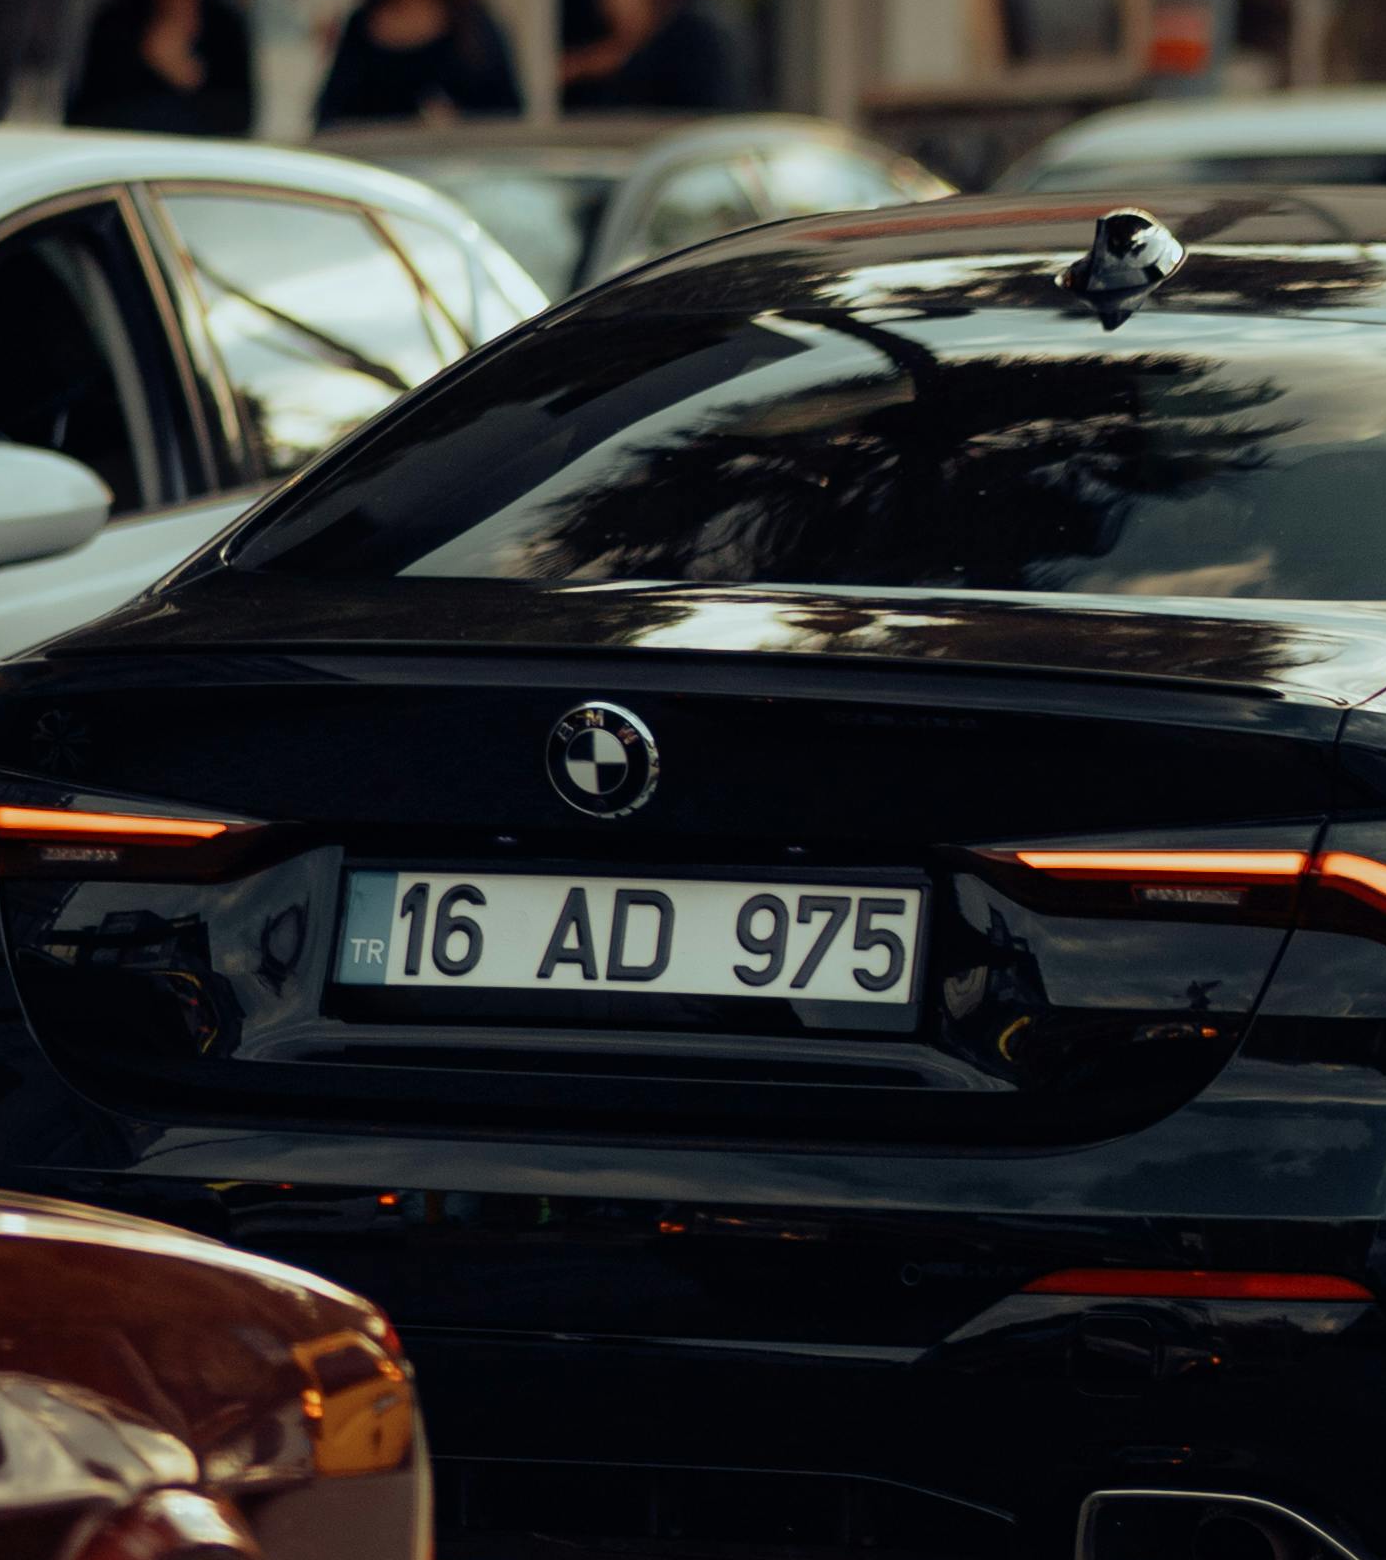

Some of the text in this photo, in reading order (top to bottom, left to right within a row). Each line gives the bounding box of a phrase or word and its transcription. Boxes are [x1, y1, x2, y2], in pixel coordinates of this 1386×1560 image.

[350, 883, 906, 992] TR 16 AD 975
